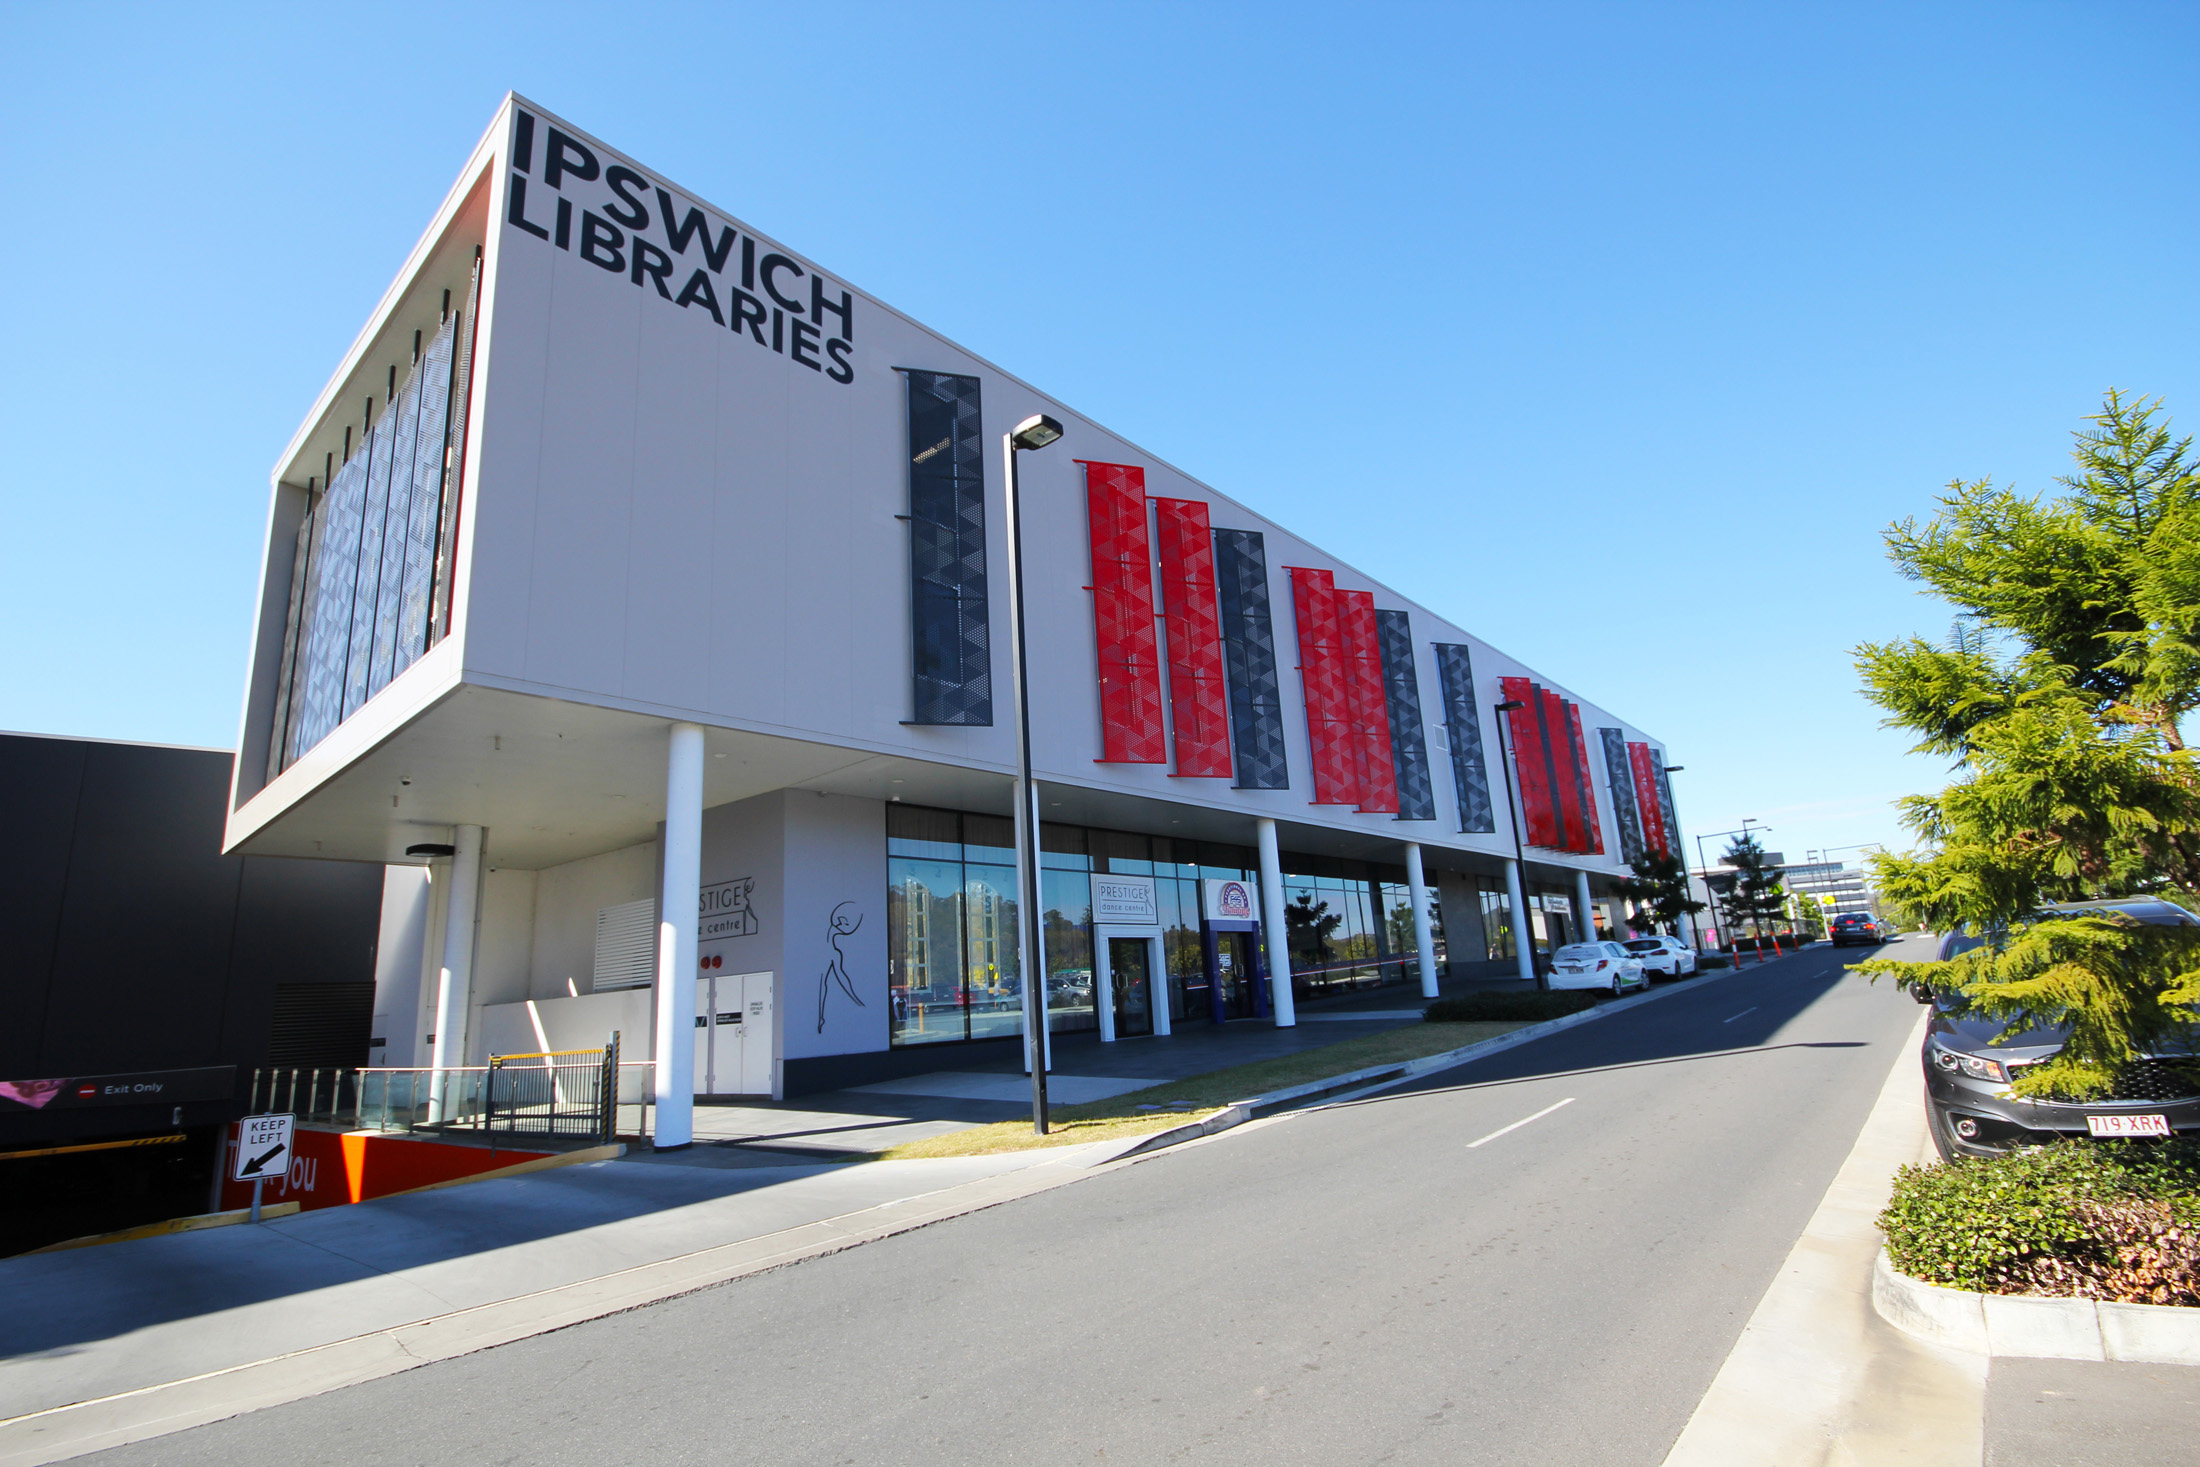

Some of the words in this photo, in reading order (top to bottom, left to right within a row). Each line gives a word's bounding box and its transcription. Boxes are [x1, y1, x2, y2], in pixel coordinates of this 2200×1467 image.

[512, 108, 853, 343] IPSWICH
[508, 172, 855, 385] LIBRARIES
[698, 886, 741, 912] STIGE
[1100, 885, 1144, 899] PRESTIGE
[1102, 903, 1122, 911] dance
[1125, 904, 1145, 912] centre
[707, 920, 740, 934] centre
[104, 1085, 129, 1095] Exit
[134, 1083, 163, 1093] Only
[251, 1120, 286, 1132] KEEP
[250, 1132, 283, 1144] LEFT
[279, 1156, 317, 1197] you
